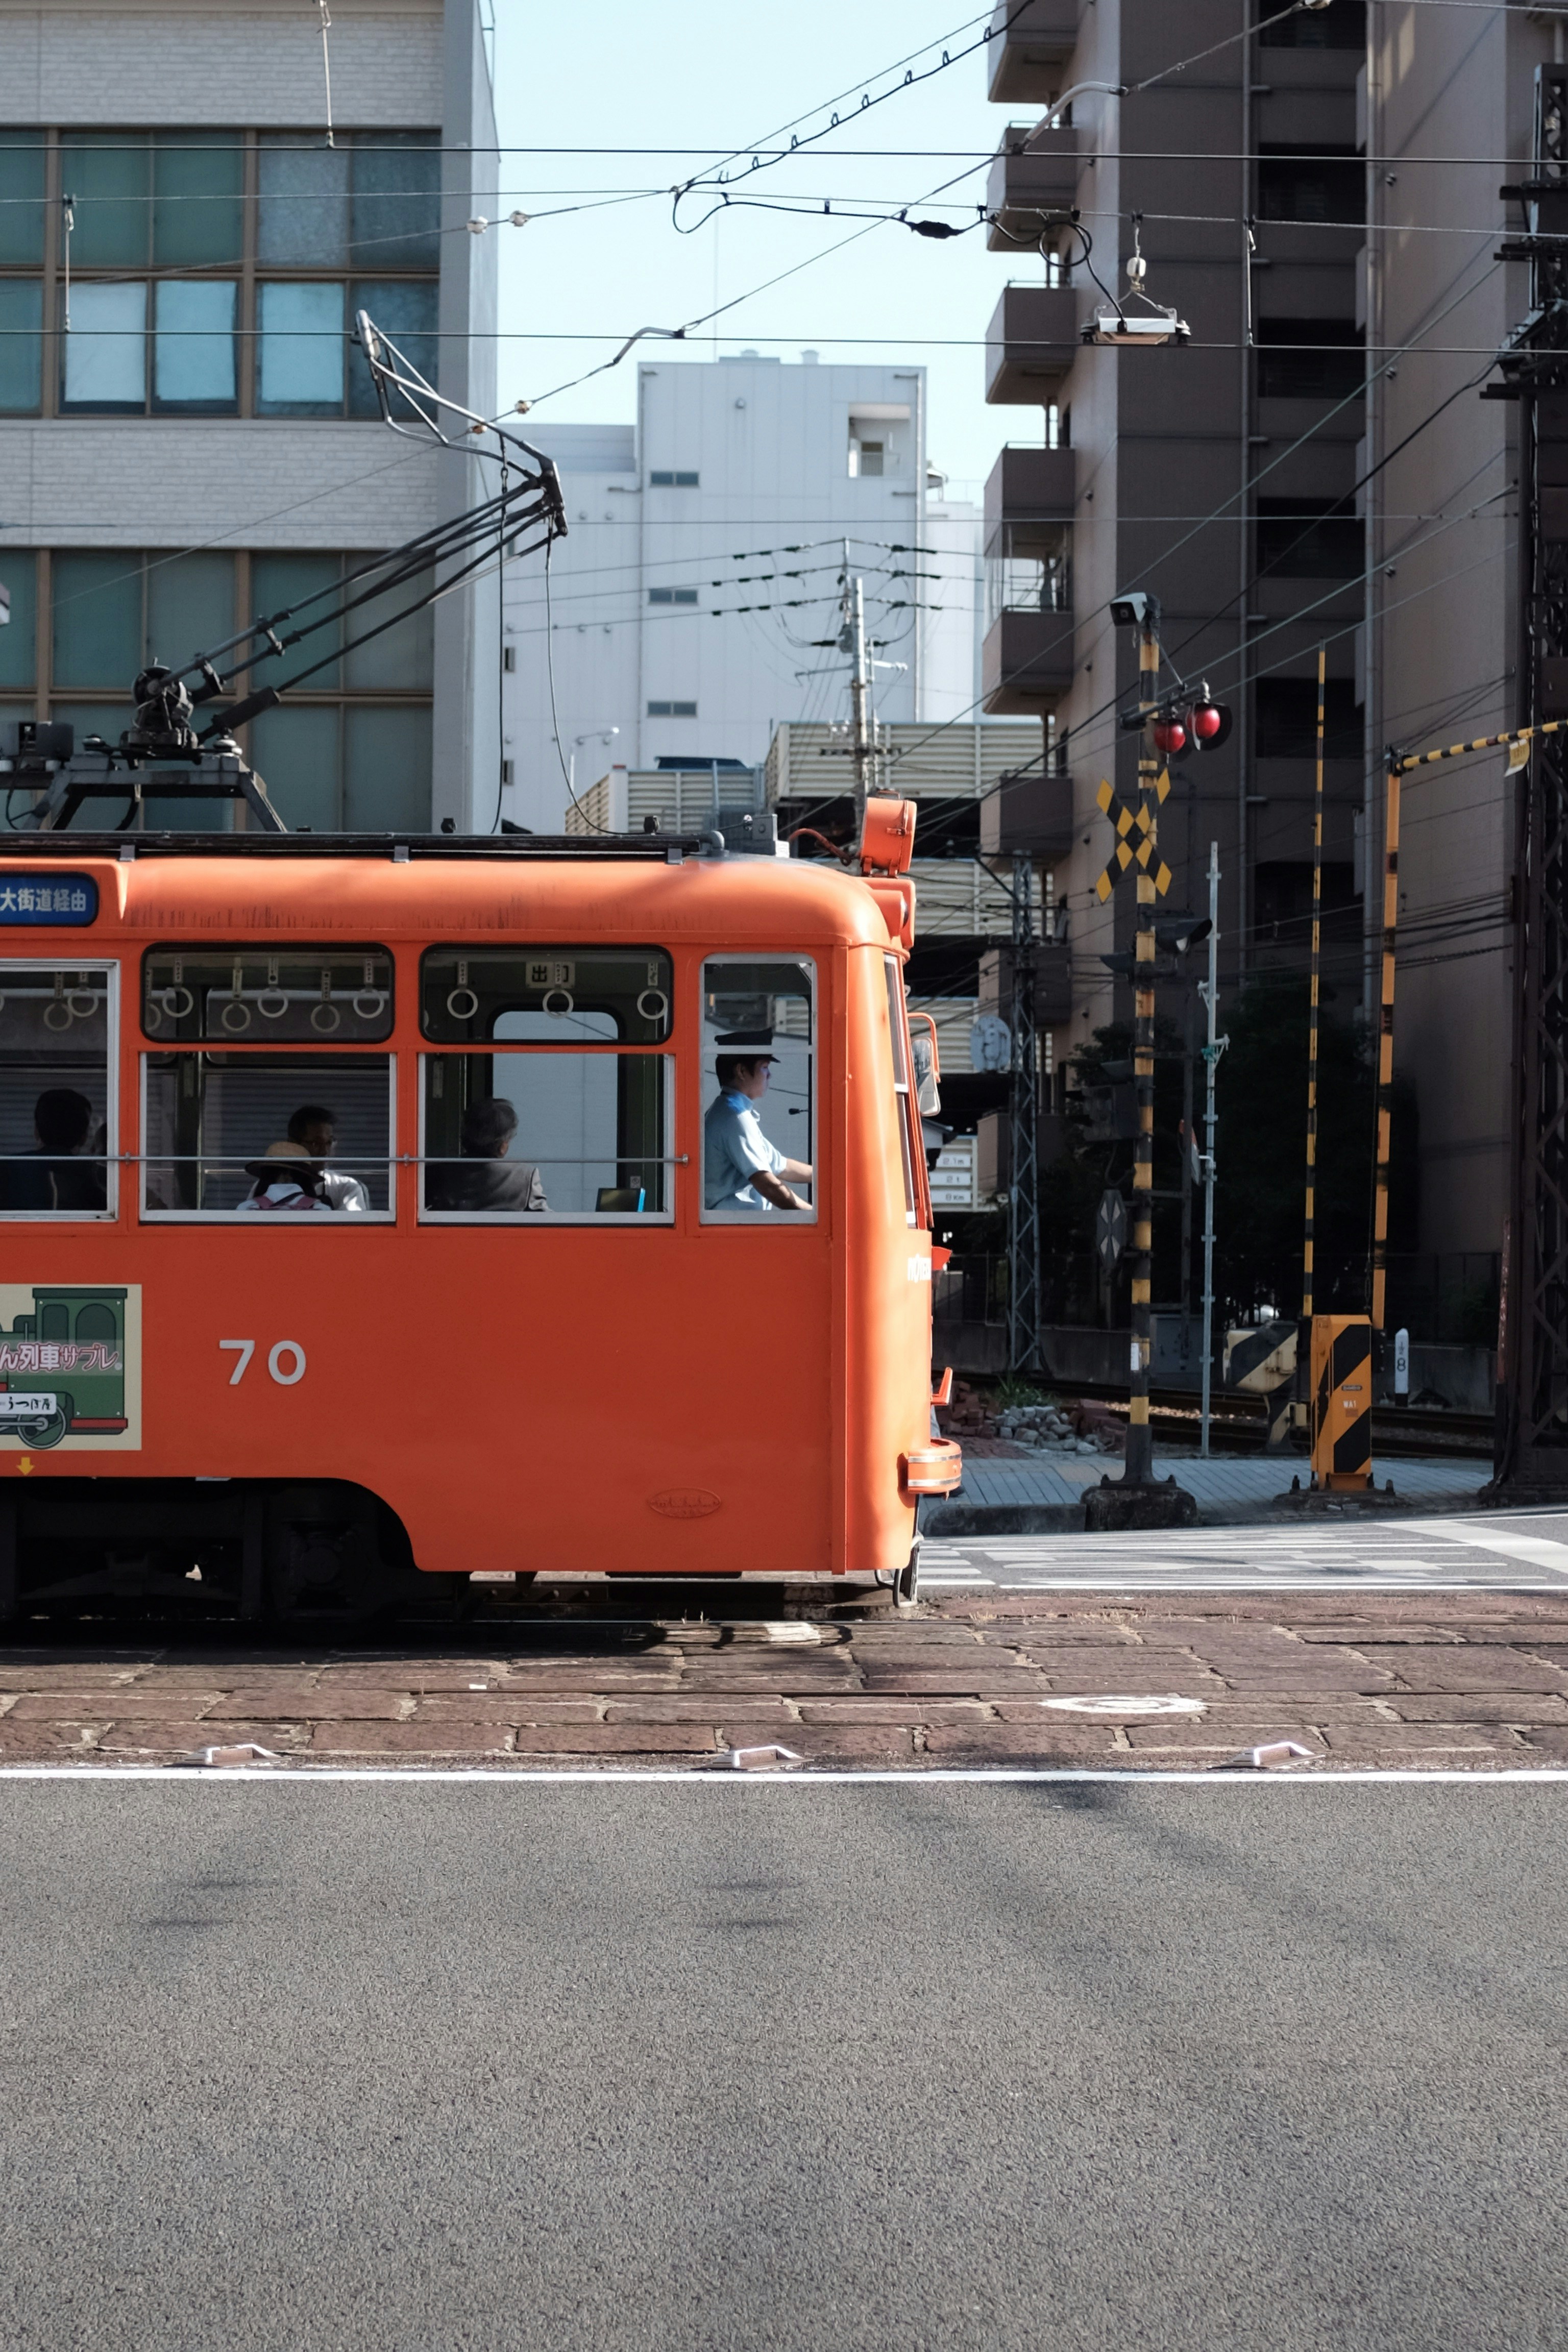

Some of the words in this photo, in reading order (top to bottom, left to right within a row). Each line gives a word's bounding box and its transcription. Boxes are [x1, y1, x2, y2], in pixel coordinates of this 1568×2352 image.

[0, 888, 86, 912] 大街道経由
[219, 1339, 306, 1385] 70
[1398, 1358, 1406, 1371] 8
[1343, 1400, 1357, 1408] WA1
